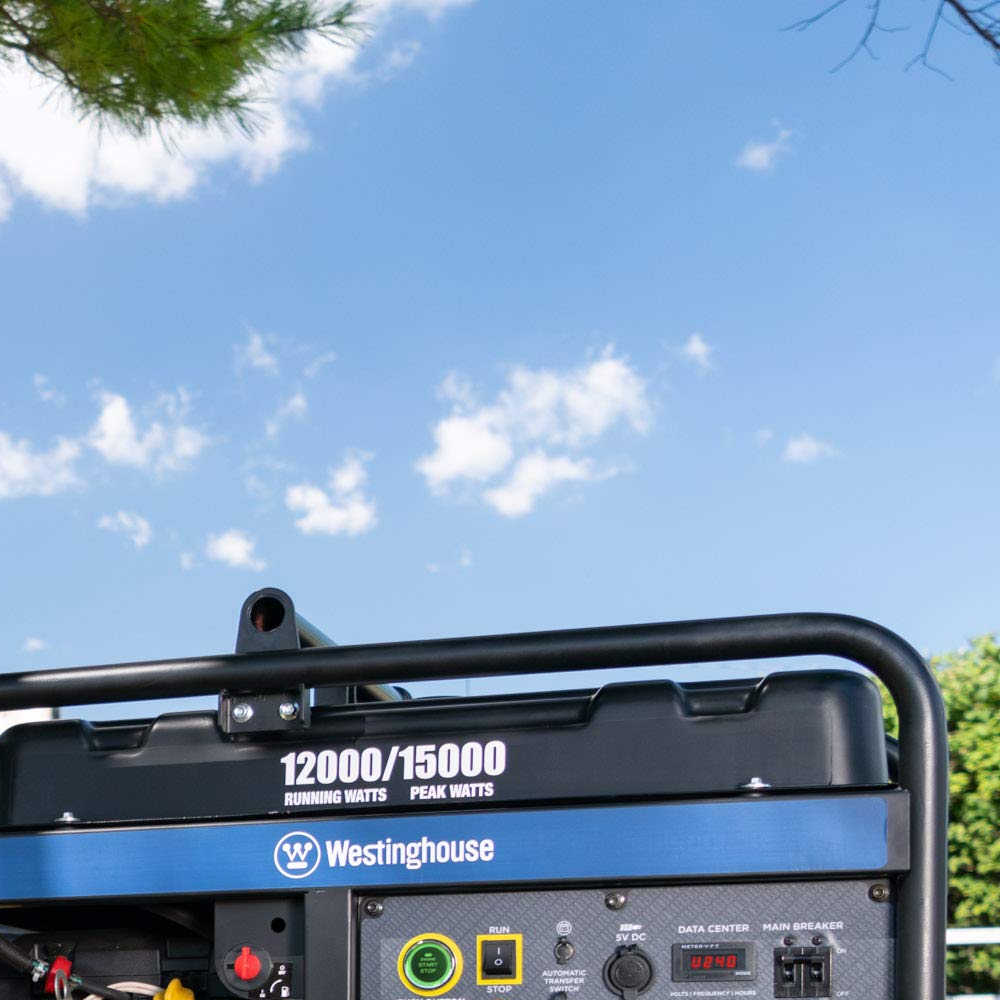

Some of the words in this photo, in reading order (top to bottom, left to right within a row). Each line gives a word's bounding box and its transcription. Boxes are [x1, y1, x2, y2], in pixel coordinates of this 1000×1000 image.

[280, 740, 507, 786] 12000/15000
[410, 785, 447, 800] PEAK
[449, 782, 495, 798] WATTS
[284, 789, 342, 806] RUNNING
[344, 787, 388, 804] WATTS
[325, 836, 495, 870] Westinghouse
[488, 926, 510, 934] RUN
[678, 925, 705, 934] DATA
[708, 924, 750, 933] CENTER
[762, 922, 790, 931] MAIN
[794, 921, 844, 931] BREAKER
[615, 933, 629, 941] 5V
[631, 932, 646, 941] DC
[541, 969, 587, 977] AUTOMATIC
[486, 985, 513, 993] STOP
